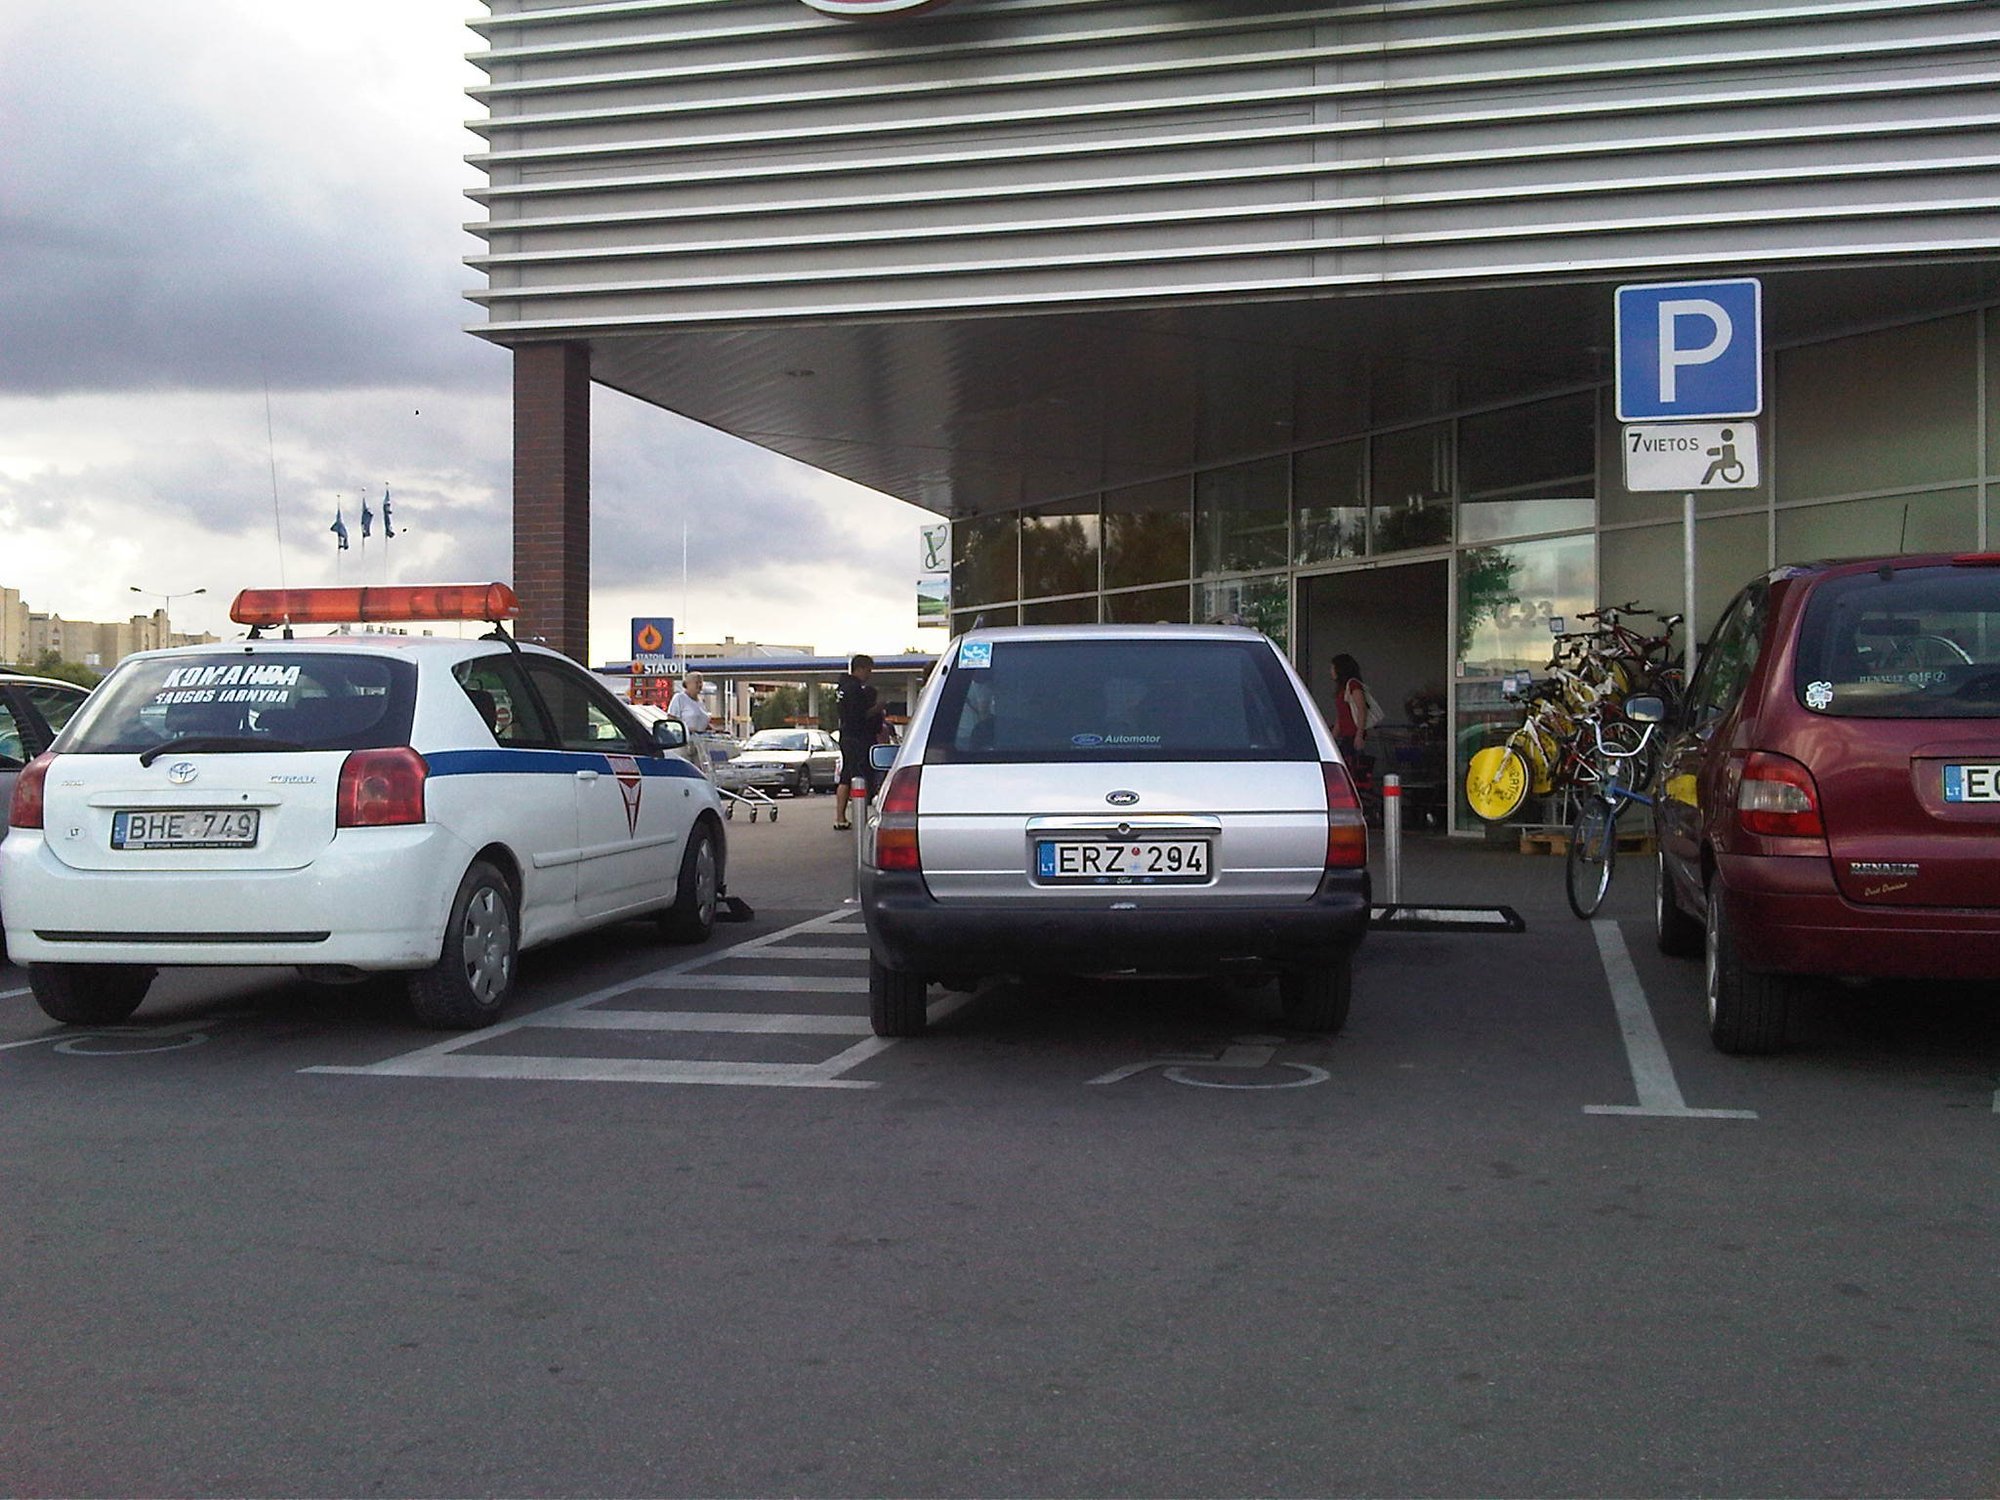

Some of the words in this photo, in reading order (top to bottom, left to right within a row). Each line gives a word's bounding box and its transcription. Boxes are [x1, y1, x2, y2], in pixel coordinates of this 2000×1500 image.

[1659, 299, 1733, 403] P
[1629, 432, 1642, 453] 7
[1643, 437, 1699, 452] VIETOS
[644, 661, 688, 674] STATOIL
[162, 665, 301, 688] KOMANDA
[1104, 733, 1161, 744] Automotor
[1946, 786, 1960, 796] LT
[70, 828, 79, 837] LT
[129, 814, 185, 840] BHE
[202, 813, 252, 839] 749
[1041, 862, 1054, 872] LT
[1059, 846, 1125, 873] ERZ
[1147, 845, 1202, 873] 294
